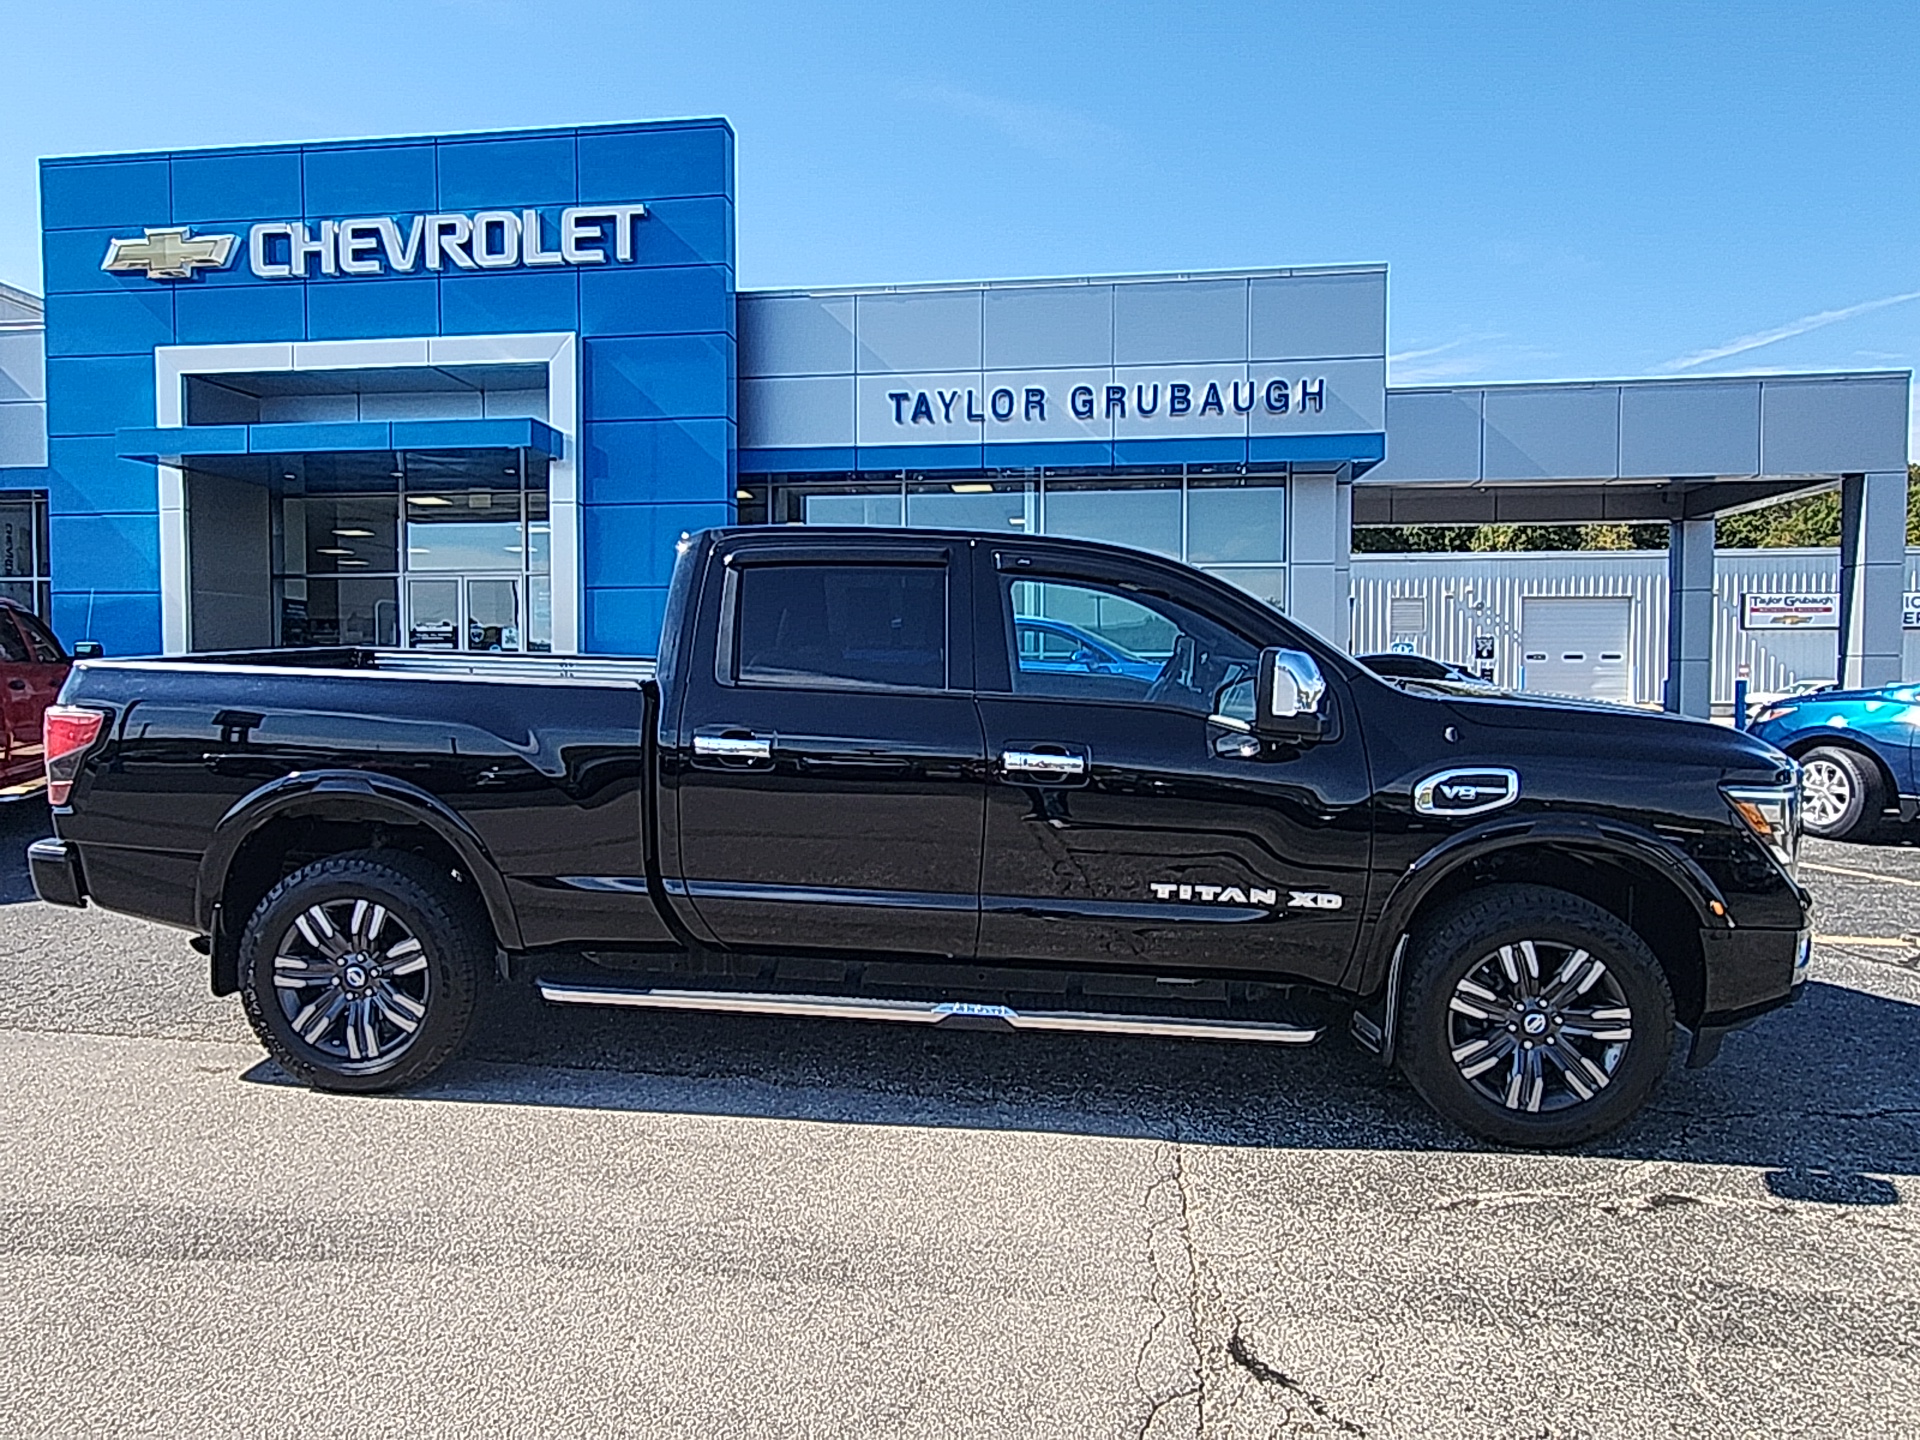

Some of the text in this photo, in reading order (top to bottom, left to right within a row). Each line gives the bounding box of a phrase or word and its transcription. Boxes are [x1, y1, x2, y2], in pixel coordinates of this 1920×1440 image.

[250, 203, 648, 279] CHEVROLET
[888, 378, 1327, 426] TAYLOR GRUBAUGH
[1750, 596, 1833, 606] Taylor Grubaugh
[1440, 784, 1477, 800] V8
[1150, 882, 1343, 910] TITAN XD
